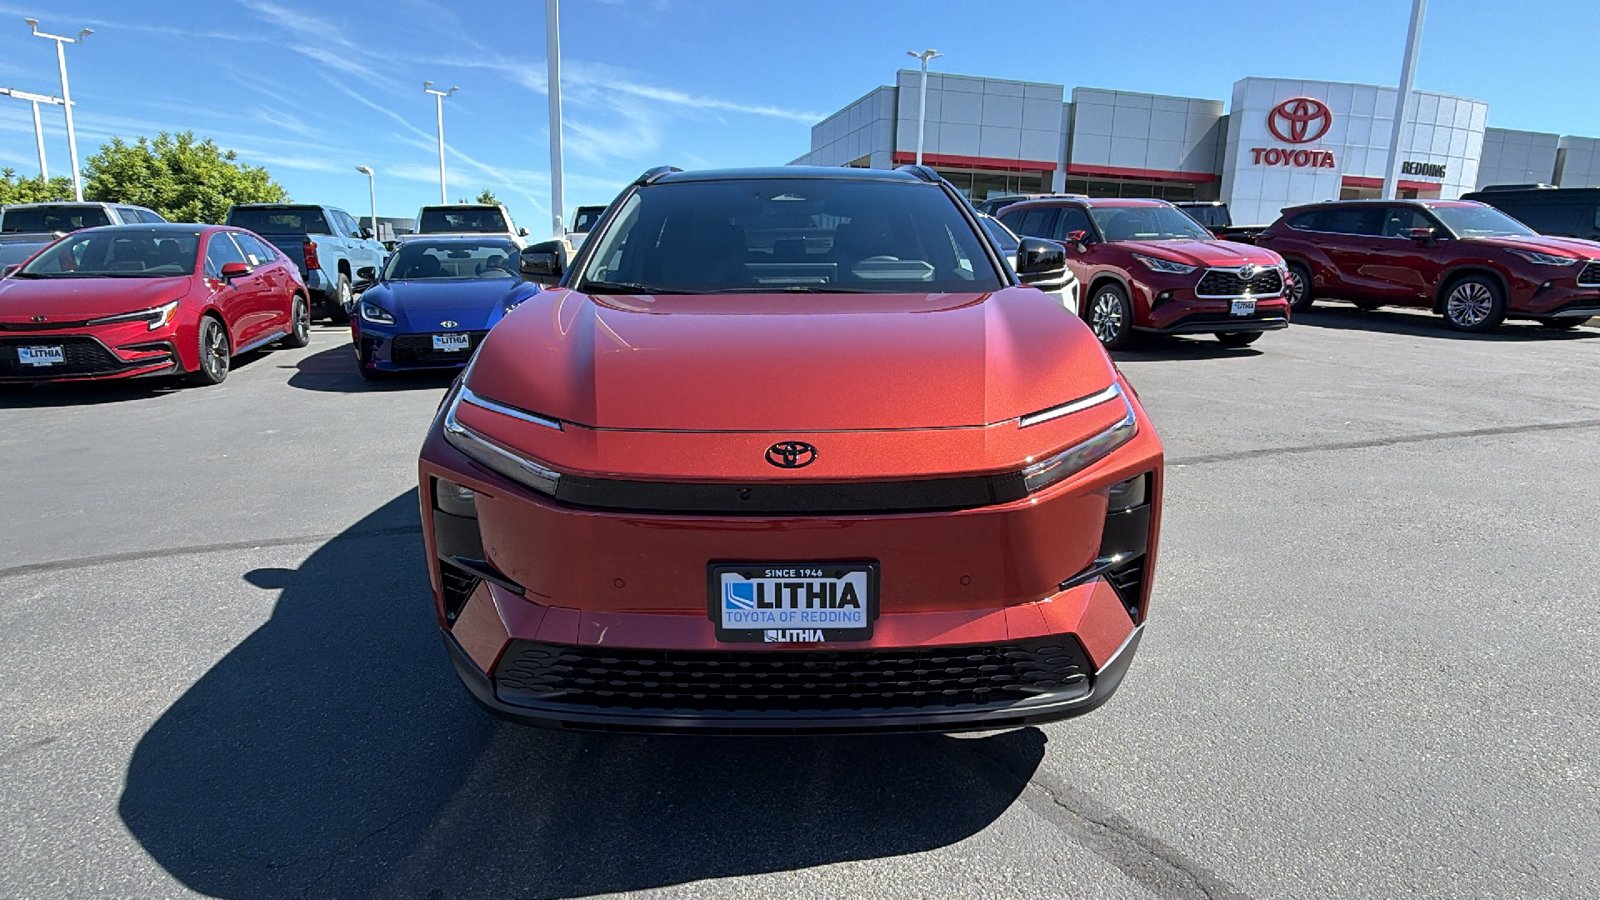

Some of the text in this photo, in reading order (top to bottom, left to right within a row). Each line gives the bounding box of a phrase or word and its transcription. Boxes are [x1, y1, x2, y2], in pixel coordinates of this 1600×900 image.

[1251, 148, 1335, 168] TOYOTA
[1401, 161, 1446, 178] REDDING
[441, 336, 467, 344] LITHIA
[30, 349, 61, 358] LITHIA
[765, 569, 823, 577] SINCE 1946
[756, 582, 861, 609] LITHIA
[725, 611, 861, 622] TOYOTA OF REDDING
[777, 629, 825, 642] LITHIA
